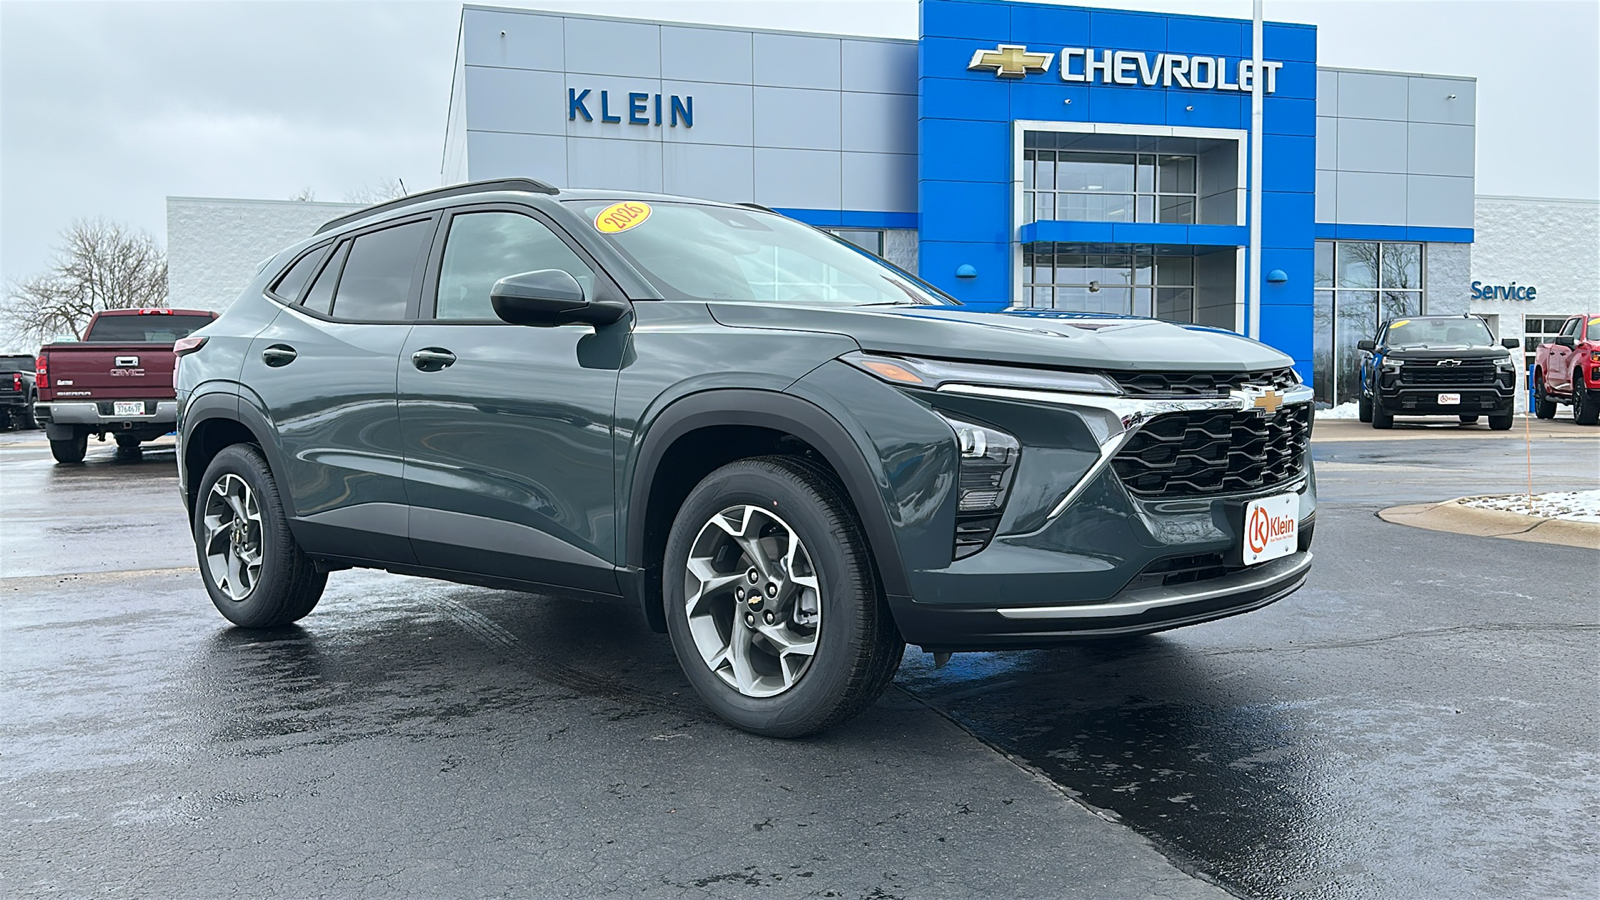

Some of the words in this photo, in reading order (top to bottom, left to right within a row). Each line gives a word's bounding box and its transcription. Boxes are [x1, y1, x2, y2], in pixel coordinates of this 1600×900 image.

[1060, 47, 1283, 93] CHEVROLET
[568, 87, 694, 129] KLEIN
[603, 203, 645, 229] 2026
[1470, 281, 1537, 301] Service
[110, 368, 145, 377] GMC
[1270, 514, 1294, 537] Klein
